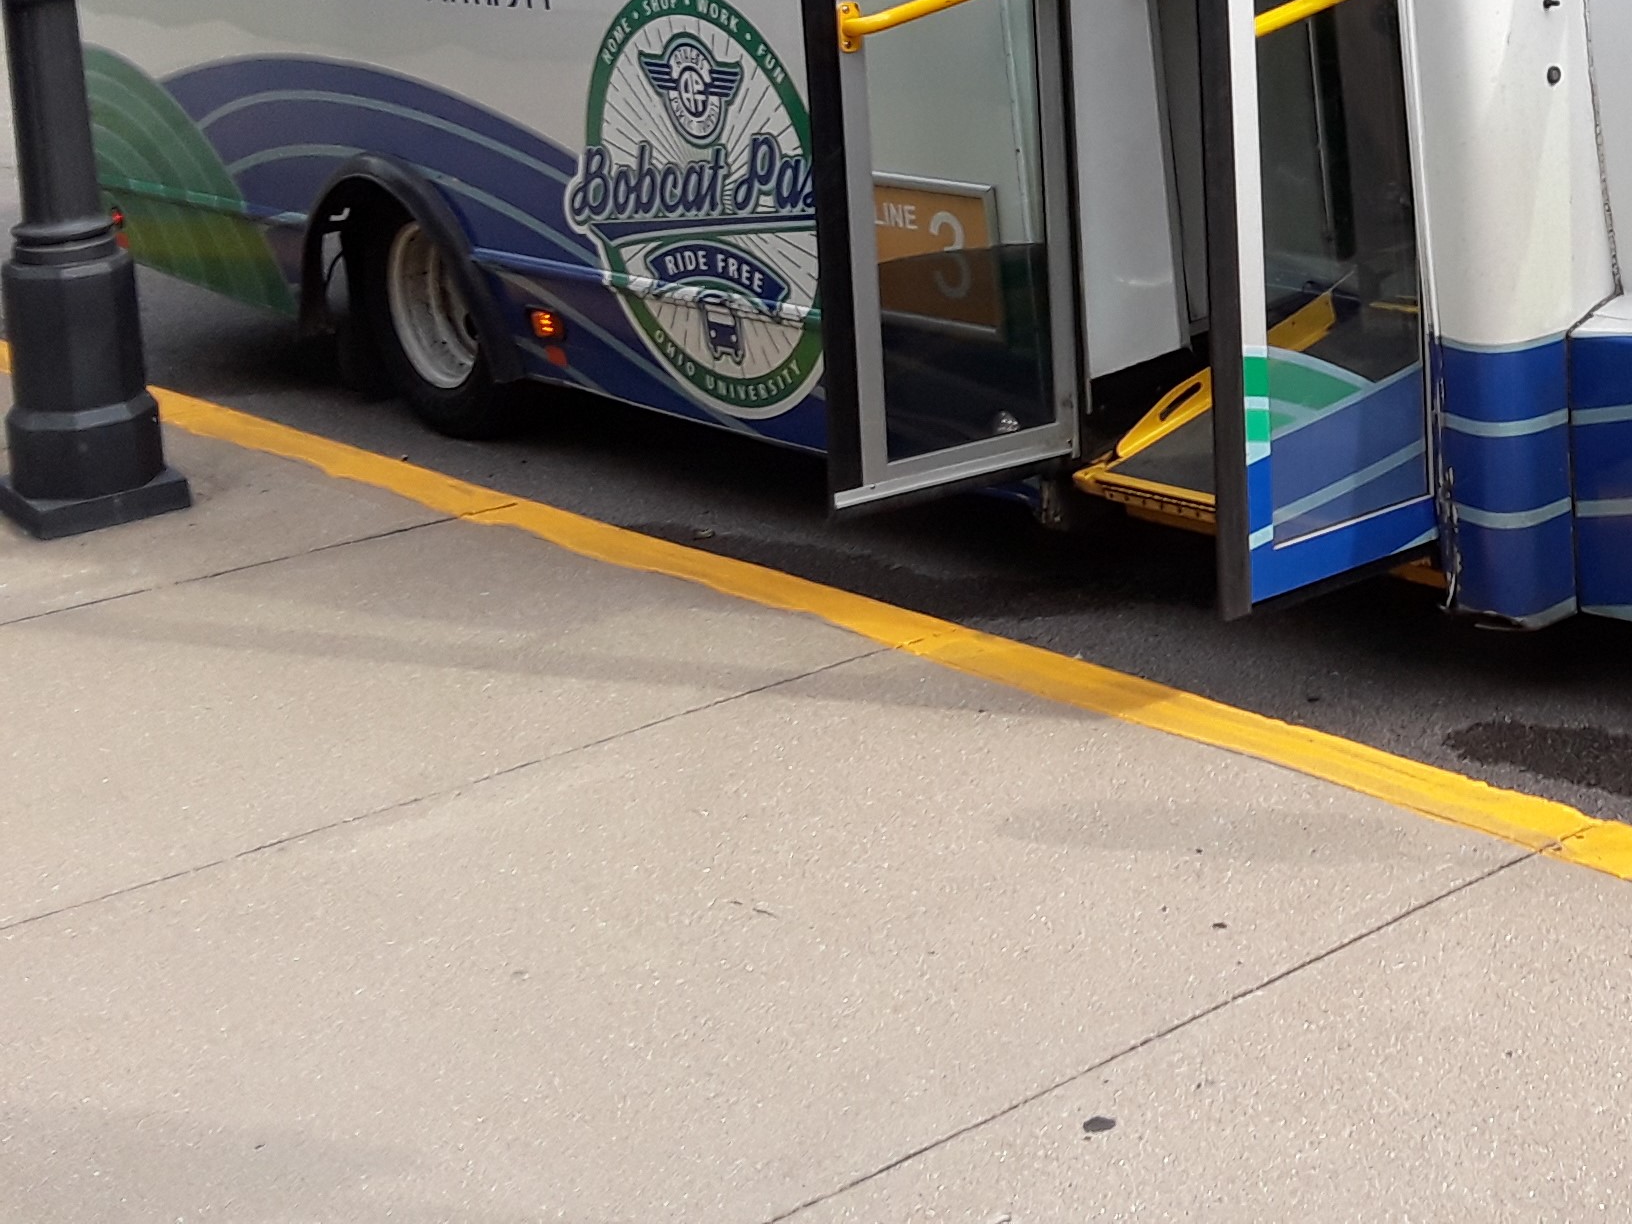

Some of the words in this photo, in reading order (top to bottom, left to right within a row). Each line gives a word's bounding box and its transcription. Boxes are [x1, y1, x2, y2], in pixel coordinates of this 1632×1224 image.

[756, 43, 787, 84] FUN
[572, 141, 725, 216] Bobcat
[733, 134, 815, 210] Pas
[665, 250, 709, 276] RIDE
[716, 254, 764, 294] FREE
[929, 211, 972, 298] 3
[654, 329, 696, 376] OHIO
[705, 359, 801, 402] UNIVERSITY
